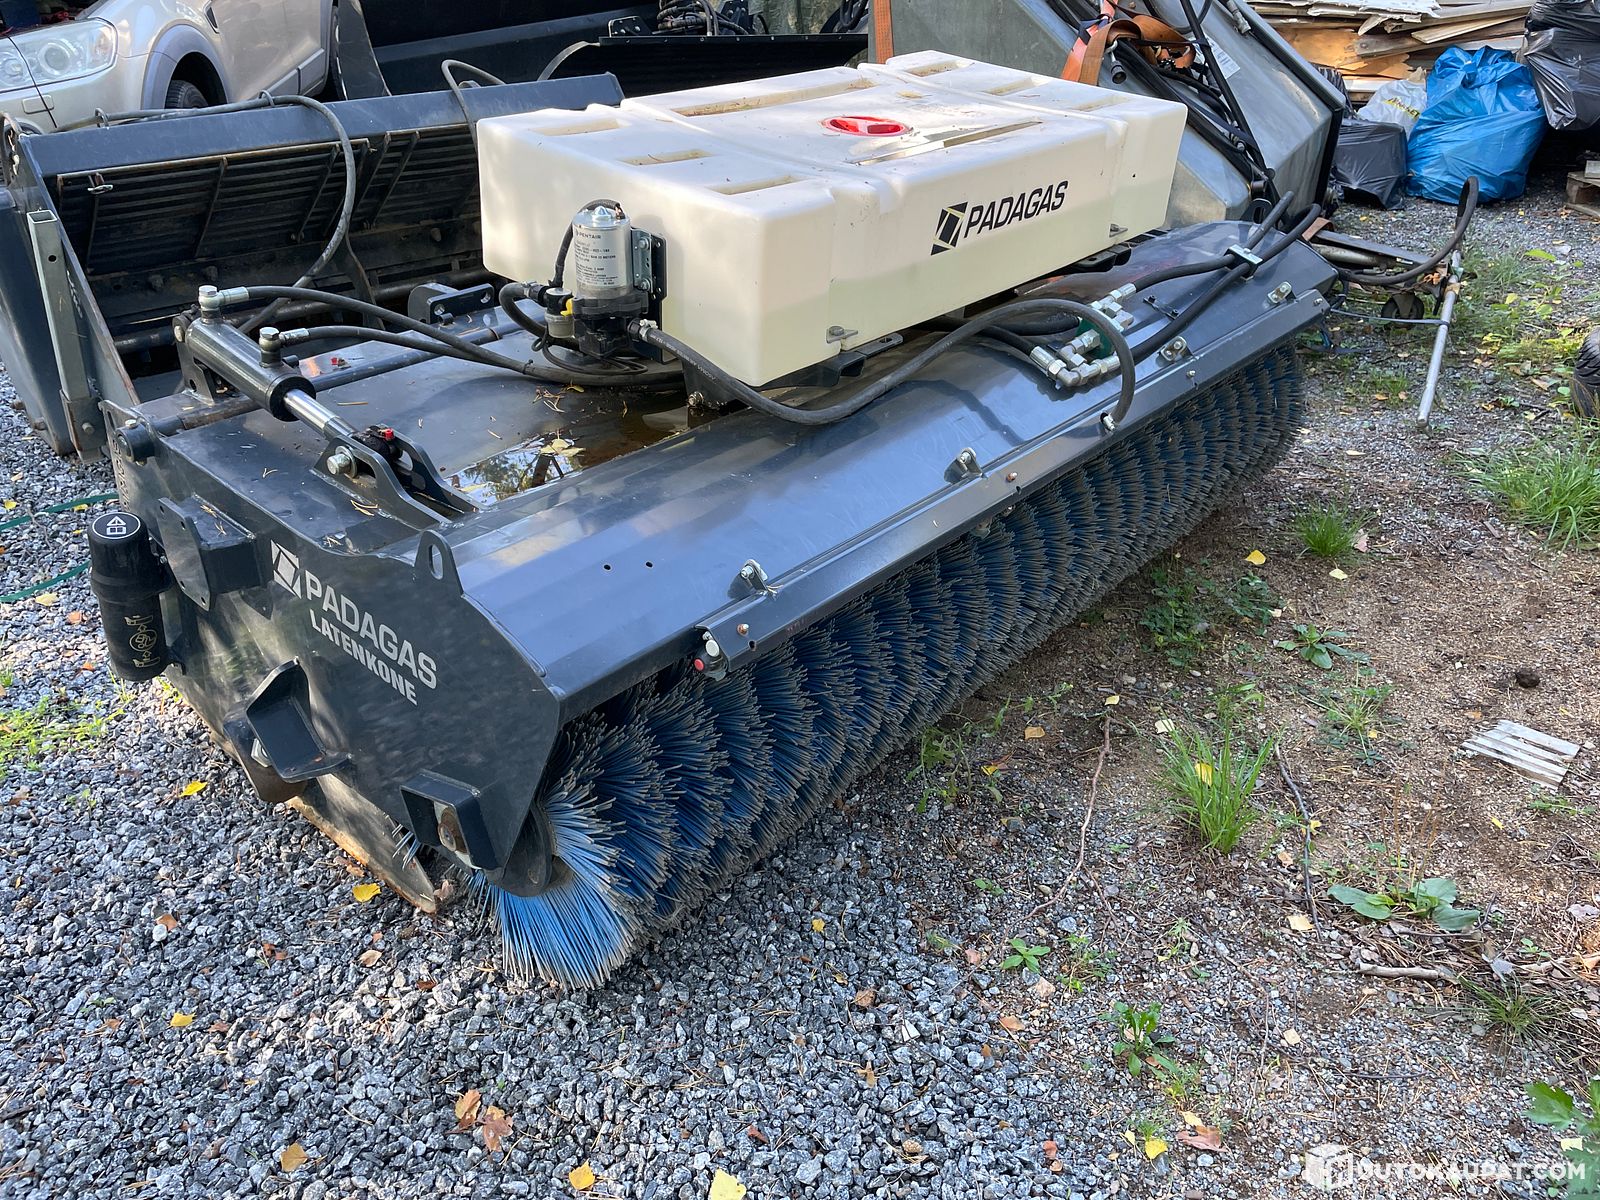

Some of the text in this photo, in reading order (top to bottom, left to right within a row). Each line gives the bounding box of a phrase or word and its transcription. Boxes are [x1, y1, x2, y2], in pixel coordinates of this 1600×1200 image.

[964, 180, 1069, 239] PADAGAS
[305, 569, 437, 690] PADAGAS
[309, 608, 418, 707] LATENKONE
